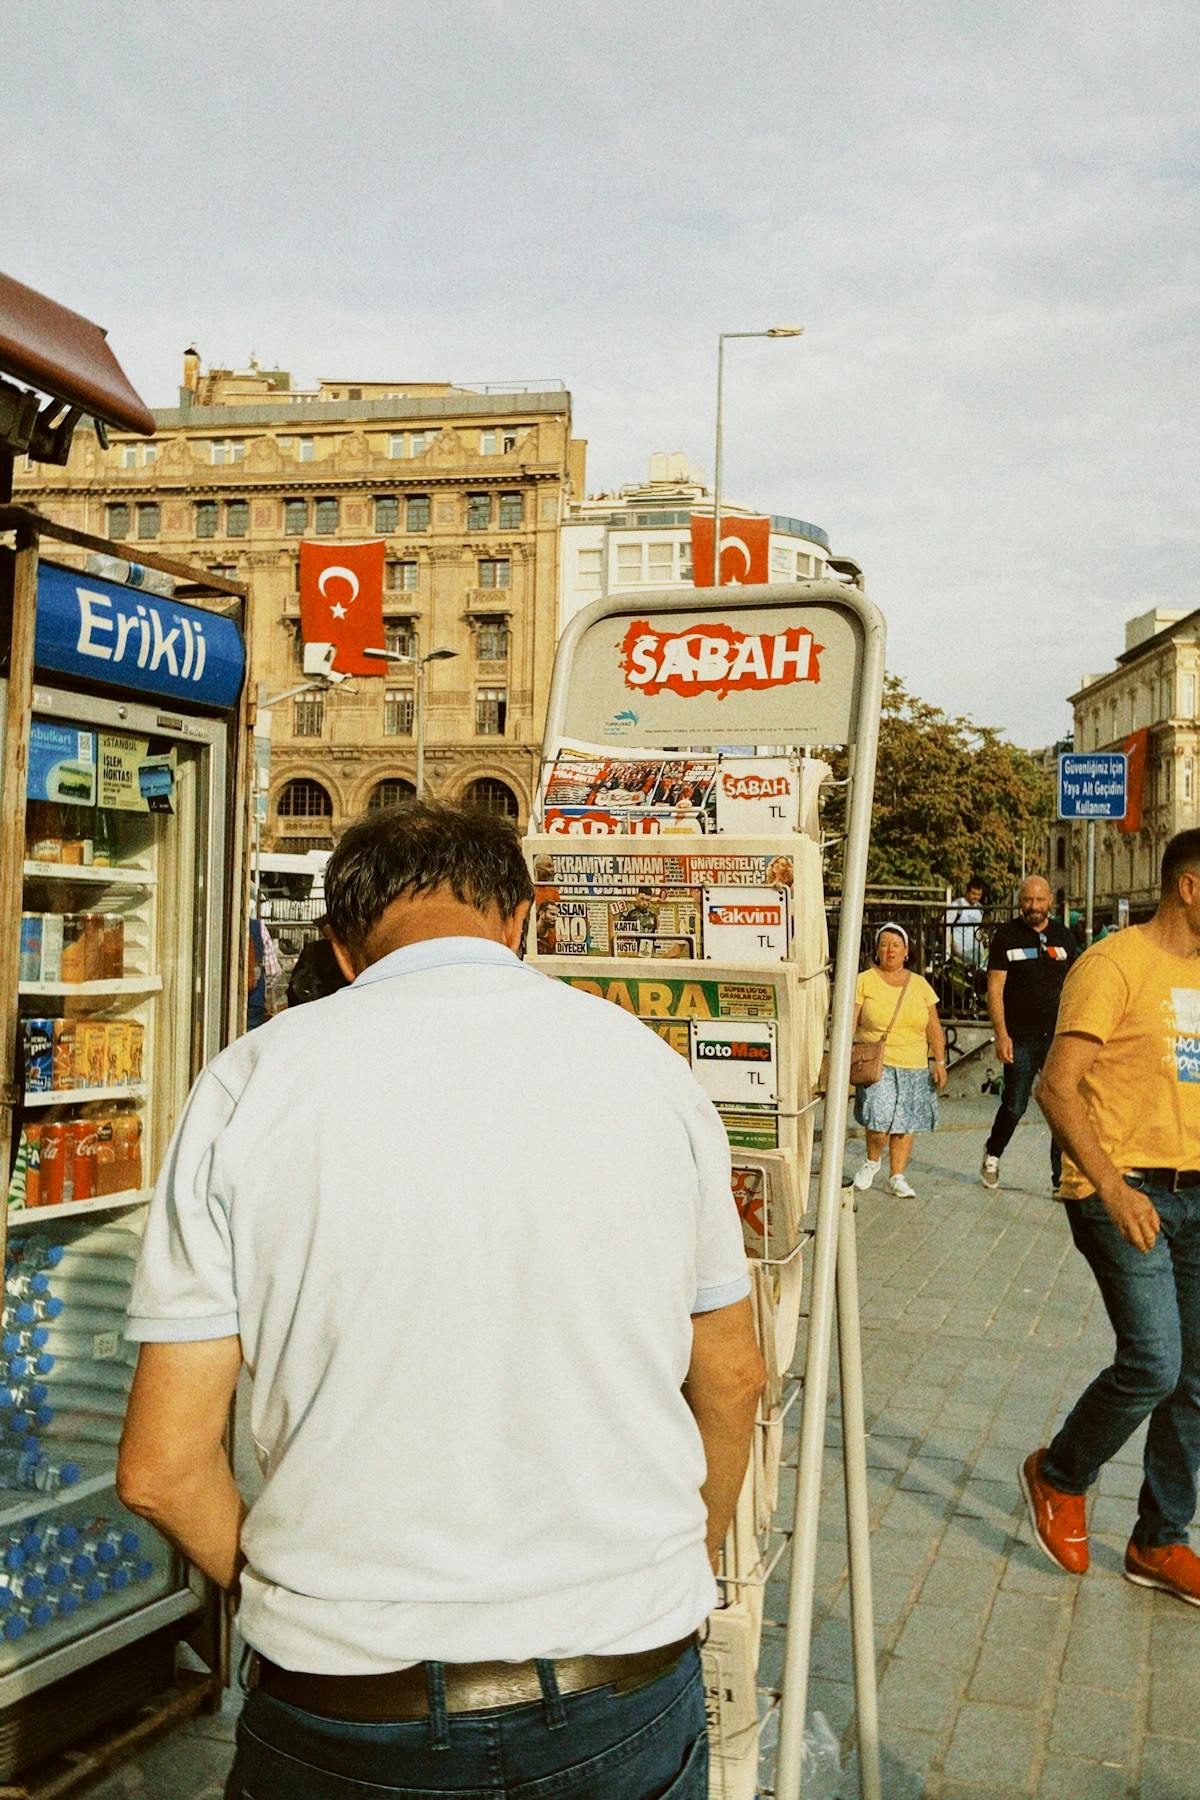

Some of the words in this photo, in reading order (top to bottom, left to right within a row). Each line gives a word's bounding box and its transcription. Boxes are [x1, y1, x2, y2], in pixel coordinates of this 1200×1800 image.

[76, 587, 207, 682] Erikli
[627, 634, 812, 684] SABAH
[1064, 760, 1108, 778] Güvenliğiniz
[1109, 758, 1123, 778] İçin
[725, 778, 787, 796] SABAH
[1063, 781, 1080, 799] Yaya
[1082, 781, 1093, 796] Alt
[1094, 781, 1124, 798] Geçidini
[768, 805, 787, 818] TL
[1075, 800, 1111, 815] Kullanınız
[553, 856, 614, 873] İKRAMİYE
[616, 856, 664, 874] TAMAM
[557, 903, 585, 916] ASLAN
[711, 907, 779, 924] Takvim
[614, 922, 639, 932] KARTAL
[757, 935, 775, 948] TL
[698, 1041, 770, 1060] fotoMaç
[747, 1071, 765, 1085] TL
